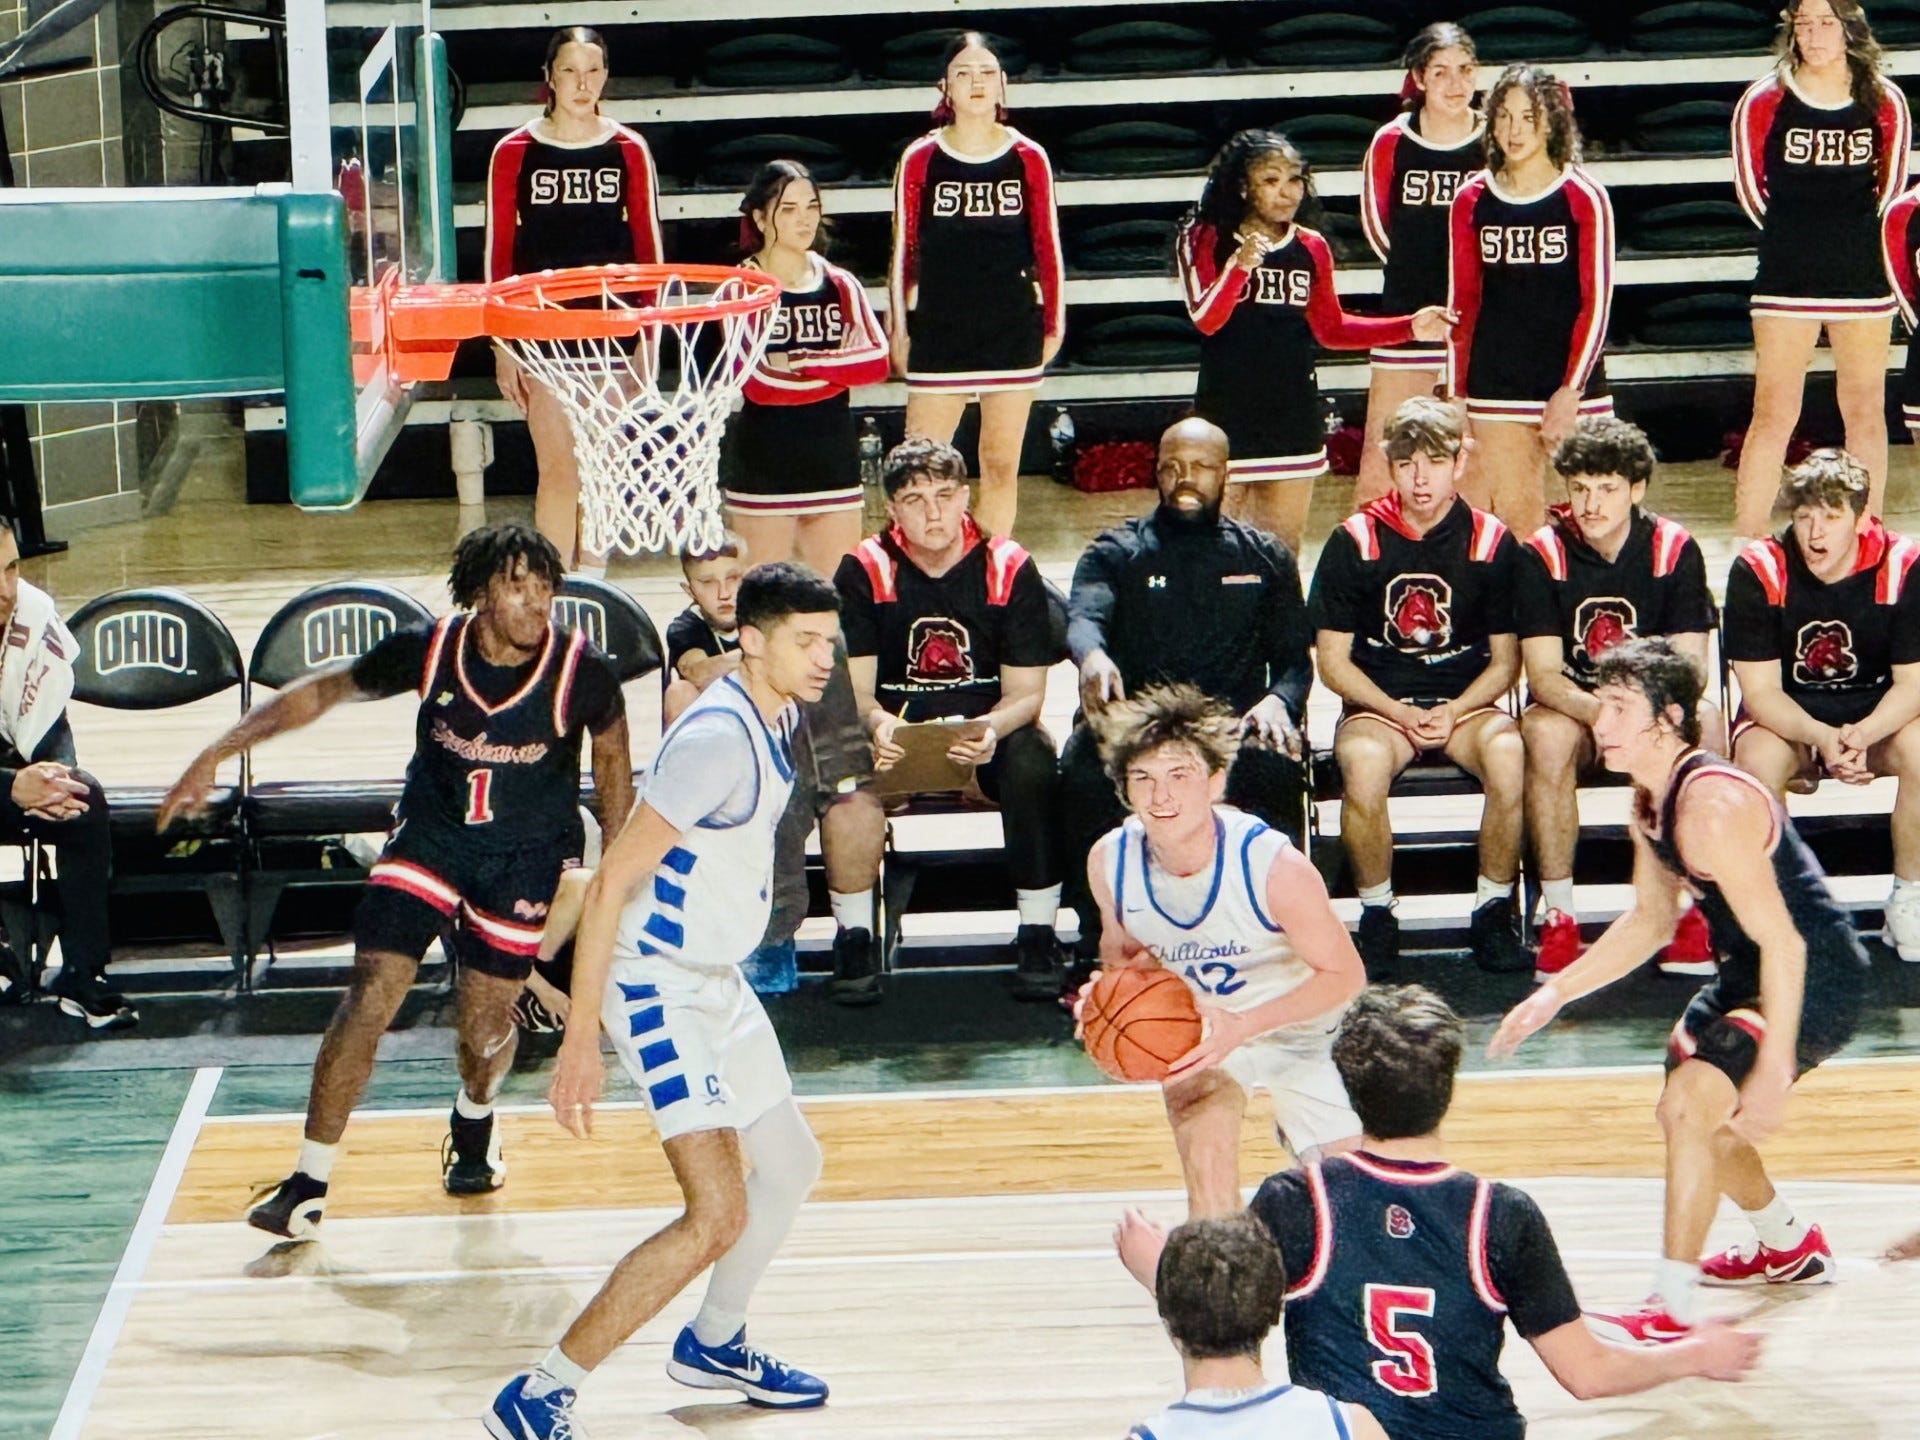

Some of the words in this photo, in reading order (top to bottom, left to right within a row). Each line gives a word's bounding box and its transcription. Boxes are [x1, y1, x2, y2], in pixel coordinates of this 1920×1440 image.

[1784, 128, 1873, 165] SHS
[531, 168, 621, 205] SHS
[933, 179, 1024, 217] SHS
[1402, 170, 1475, 206] SH
[1480, 225, 1568, 264] SHS
[95, 610, 188, 676] OHIO
[464, 768, 494, 825] 1
[1184, 962, 1247, 996] 12
[1363, 1282, 1438, 1398] 5
